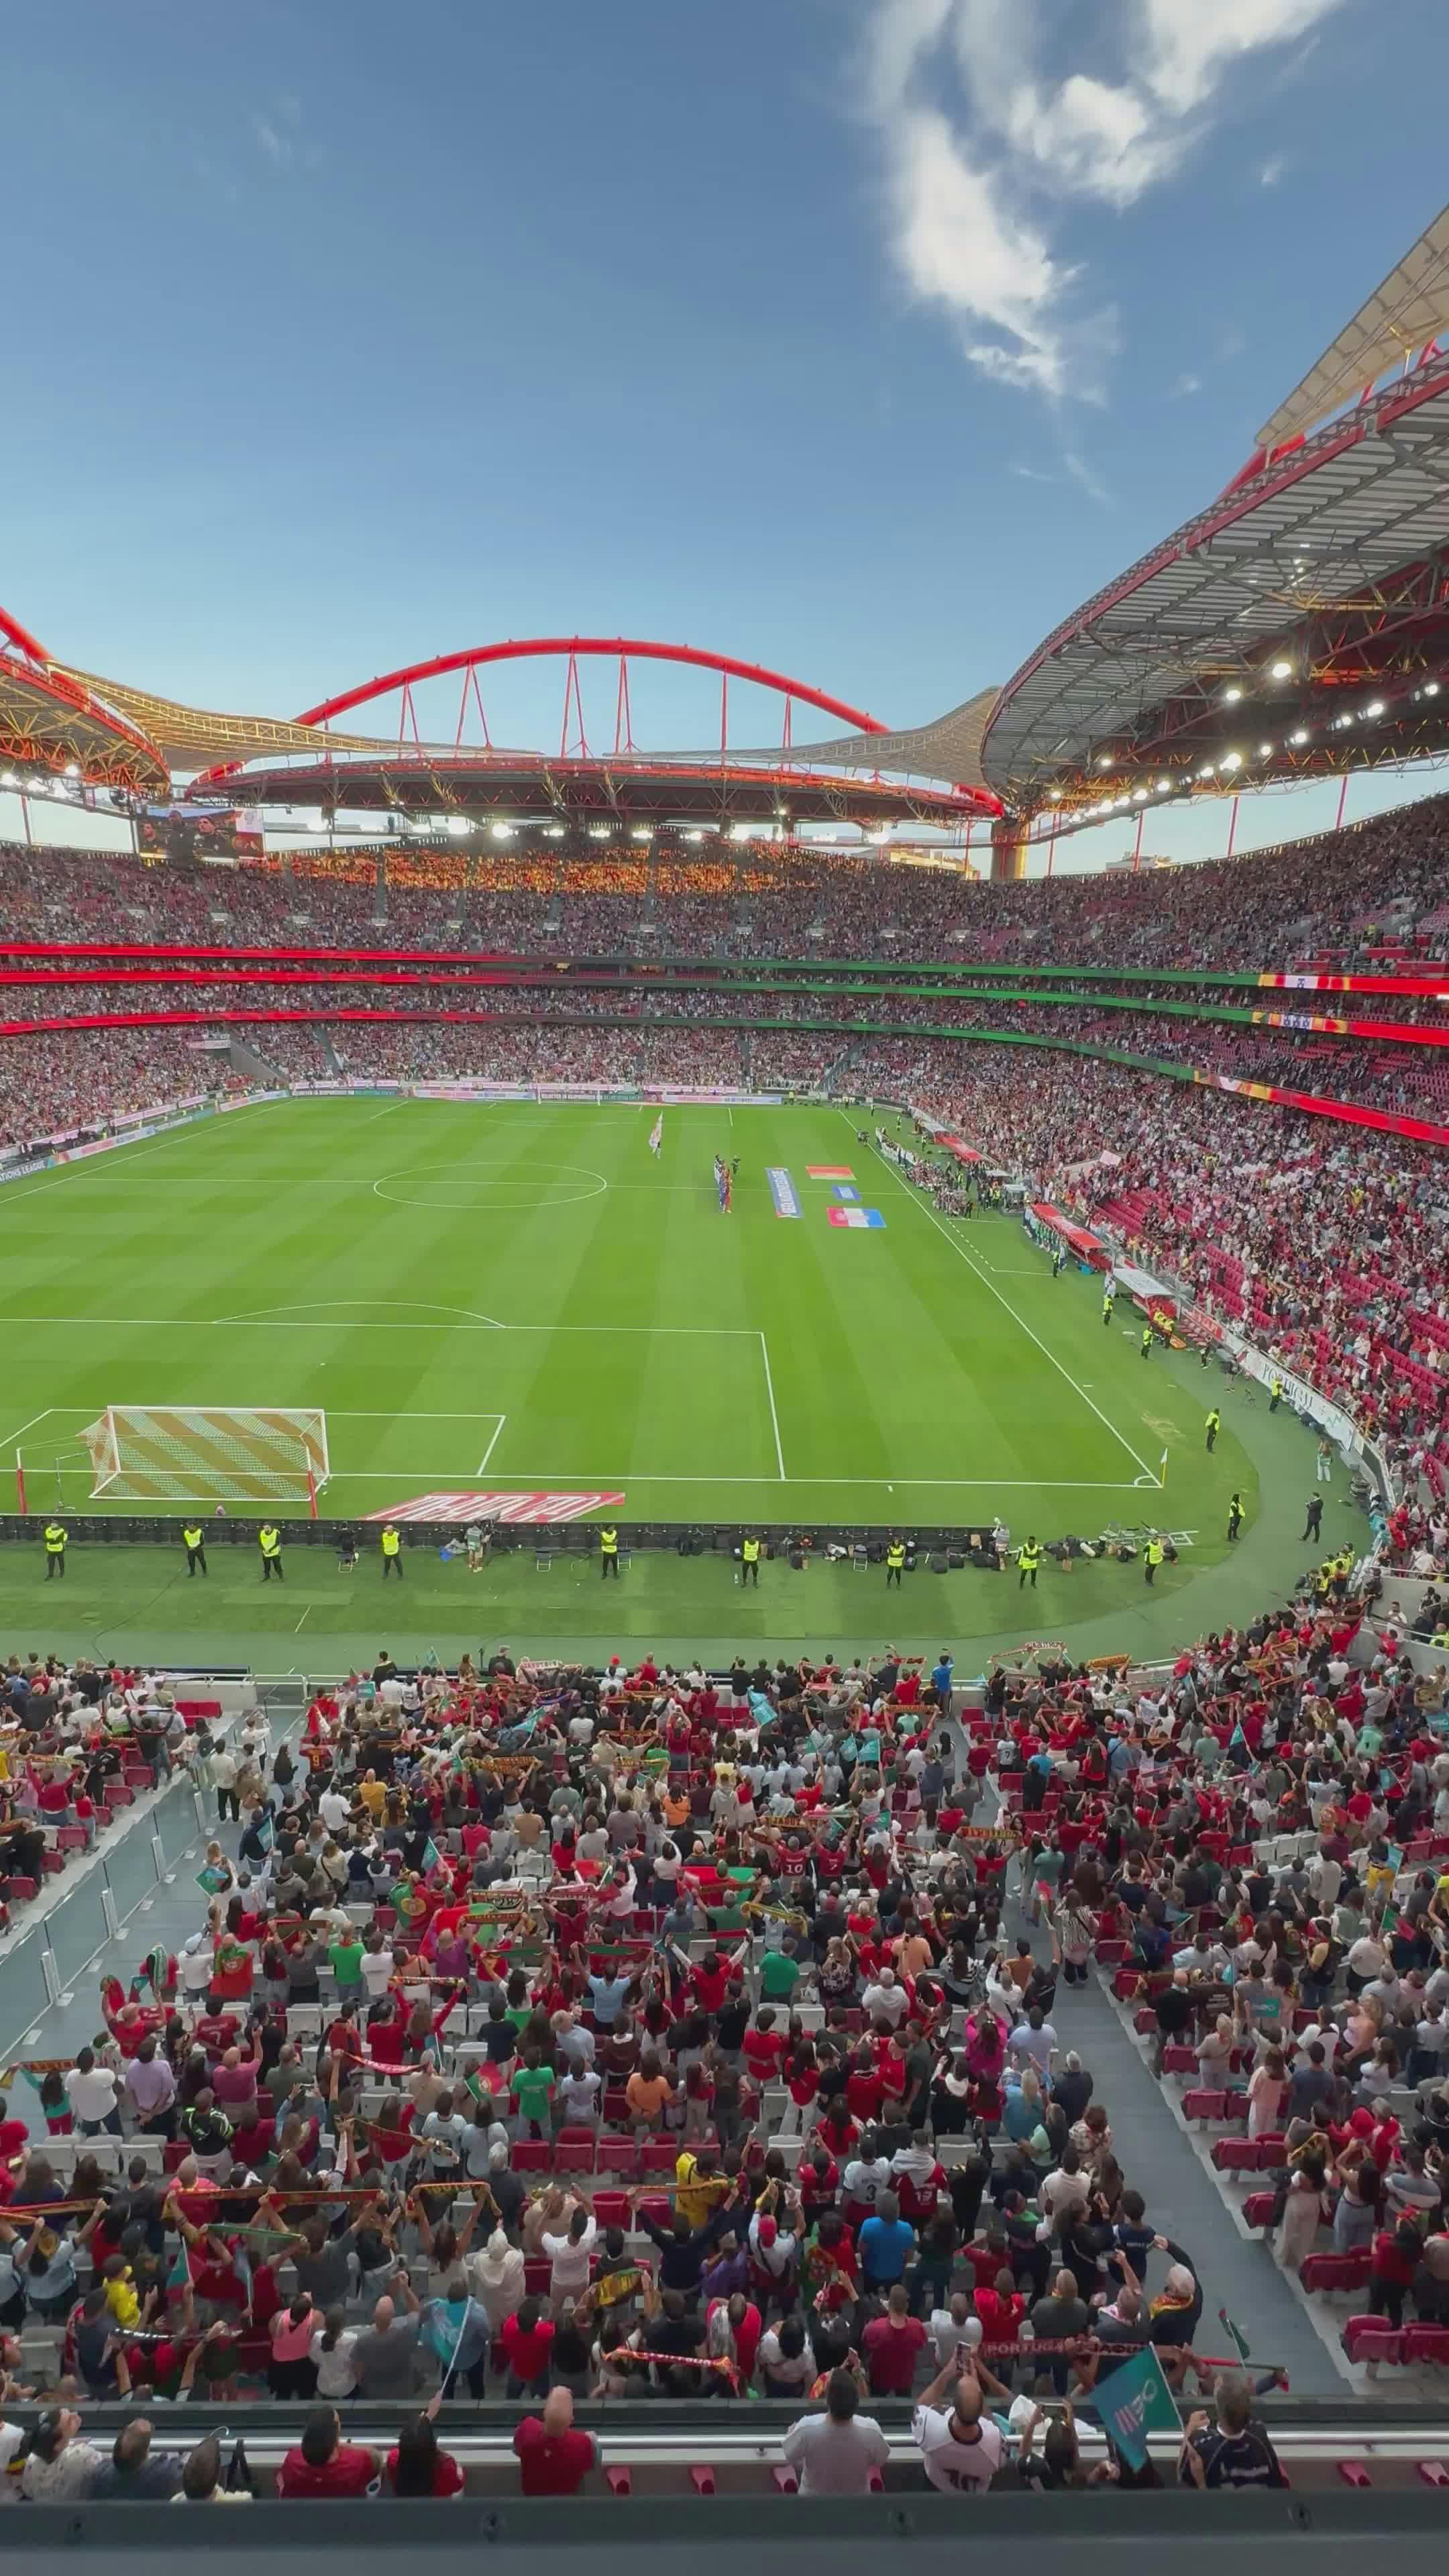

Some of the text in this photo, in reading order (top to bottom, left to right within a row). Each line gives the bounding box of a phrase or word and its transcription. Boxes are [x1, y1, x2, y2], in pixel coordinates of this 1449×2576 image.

[21, 1160, 46, 1174] LEAGUE
[313, 1755, 320, 1766] 9
[787, 1864, 803, 1874] 10
[209, 2031, 221, 2045] 7
[866, 2184, 876, 2201] 3
[987, 2341, 1067, 2355] PORTUGA
